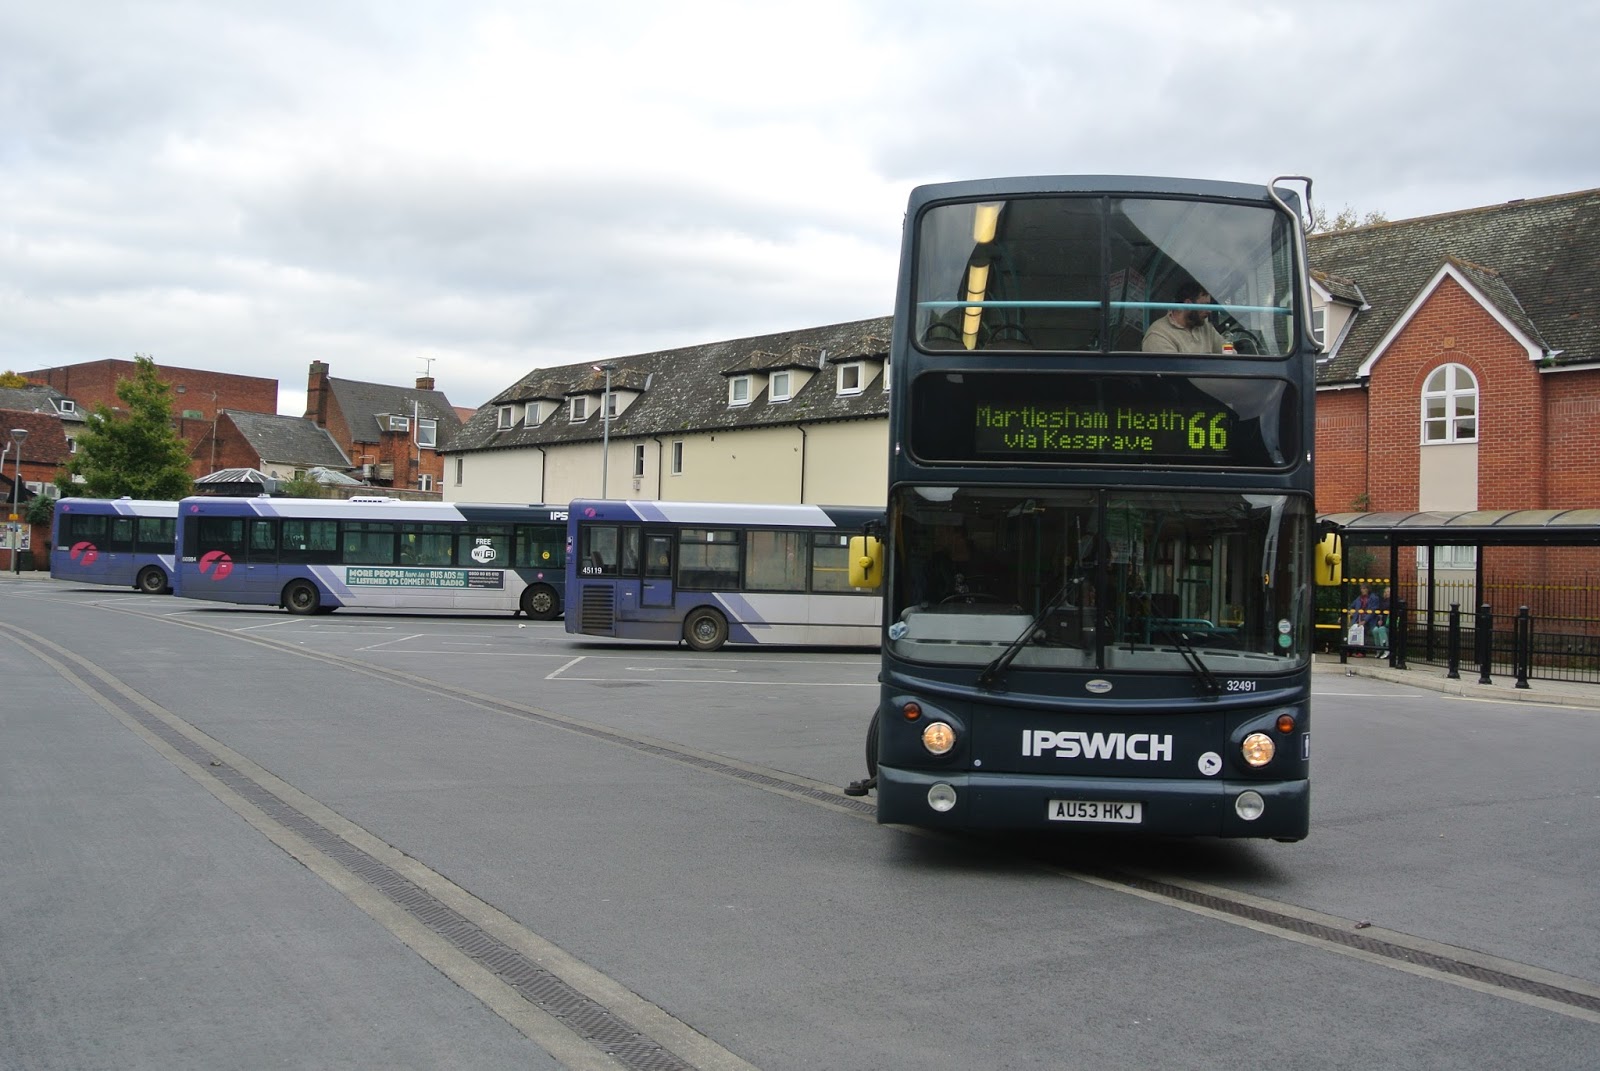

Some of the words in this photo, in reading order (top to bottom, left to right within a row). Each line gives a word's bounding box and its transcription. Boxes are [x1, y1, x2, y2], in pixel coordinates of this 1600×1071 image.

[976, 406, 1108, 429] Martlesham
[1117, 407, 1185, 431] Heath
[1004, 429, 1037, 449] via
[1043, 429, 1153, 451] Kesgrave
[1187, 411, 1228, 450] 66
[349, 569, 373, 577] MORE
[374, 570, 404, 578] PEOPLE
[430, 571, 442, 579] BUS
[444, 571, 456, 580] ADS
[1226, 680, 1256, 692] 32491
[1022, 730, 1173, 761] IPSWICH
[1056, 802, 1098, 819] AU53
[1103, 803, 1135, 820] HKJ
